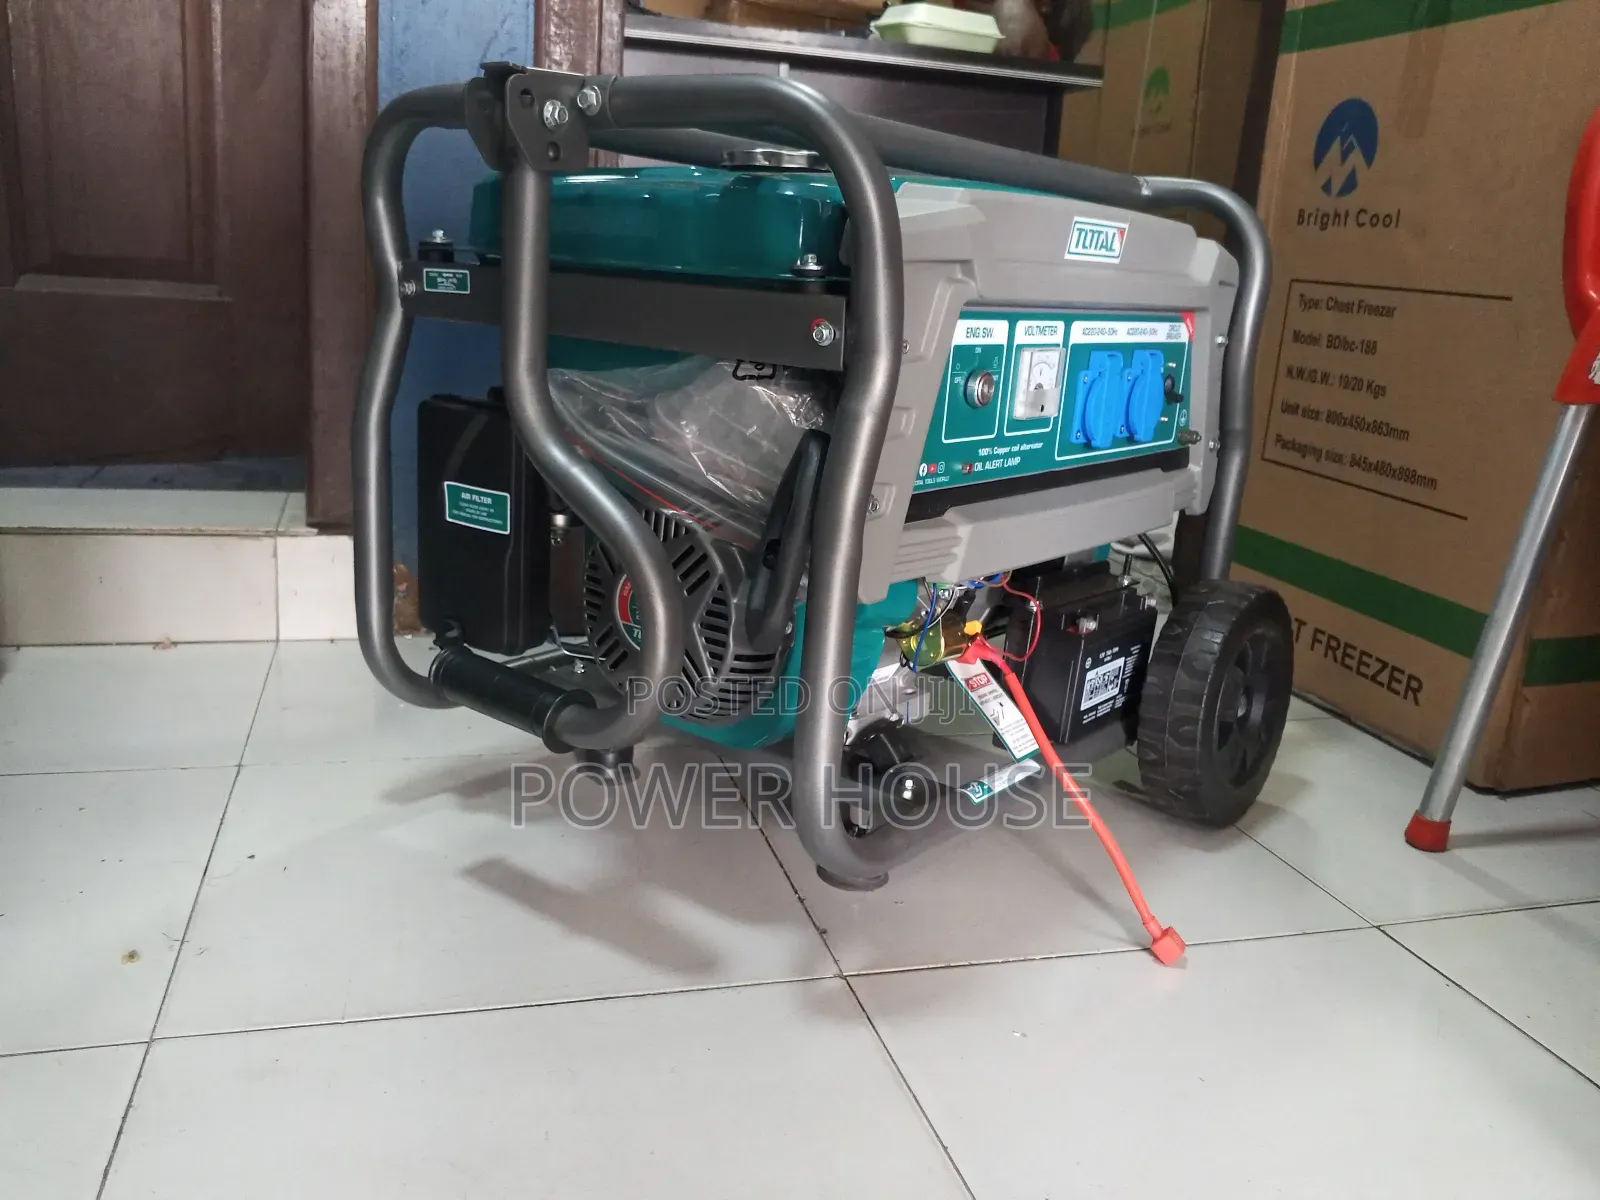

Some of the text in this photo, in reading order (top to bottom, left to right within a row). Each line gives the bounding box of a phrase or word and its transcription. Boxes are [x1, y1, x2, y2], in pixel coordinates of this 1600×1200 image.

[1297, 207, 1401, 232] Bright Cool
[1299, 293, 1397, 319] Type: Chest Freezer
[1024, 325, 1058, 337] VOLTMETER
[1366, 380, 1387, 400] Kgs
[1280, 400, 1300, 416] Unit
[1325, 408, 1410, 442] 800x450x863mm
[978, 448, 992, 457] 100%
[993, 446, 1010, 456] Copper
[1274, 433, 1323, 463] Packaging
[973, 456, 1021, 472] OIL ALERT LAMP
[461, 492, 493, 504] AIR FILTER
[1310, 627, 1424, 708] FREEZER
[968, 675, 988, 689] STOP
